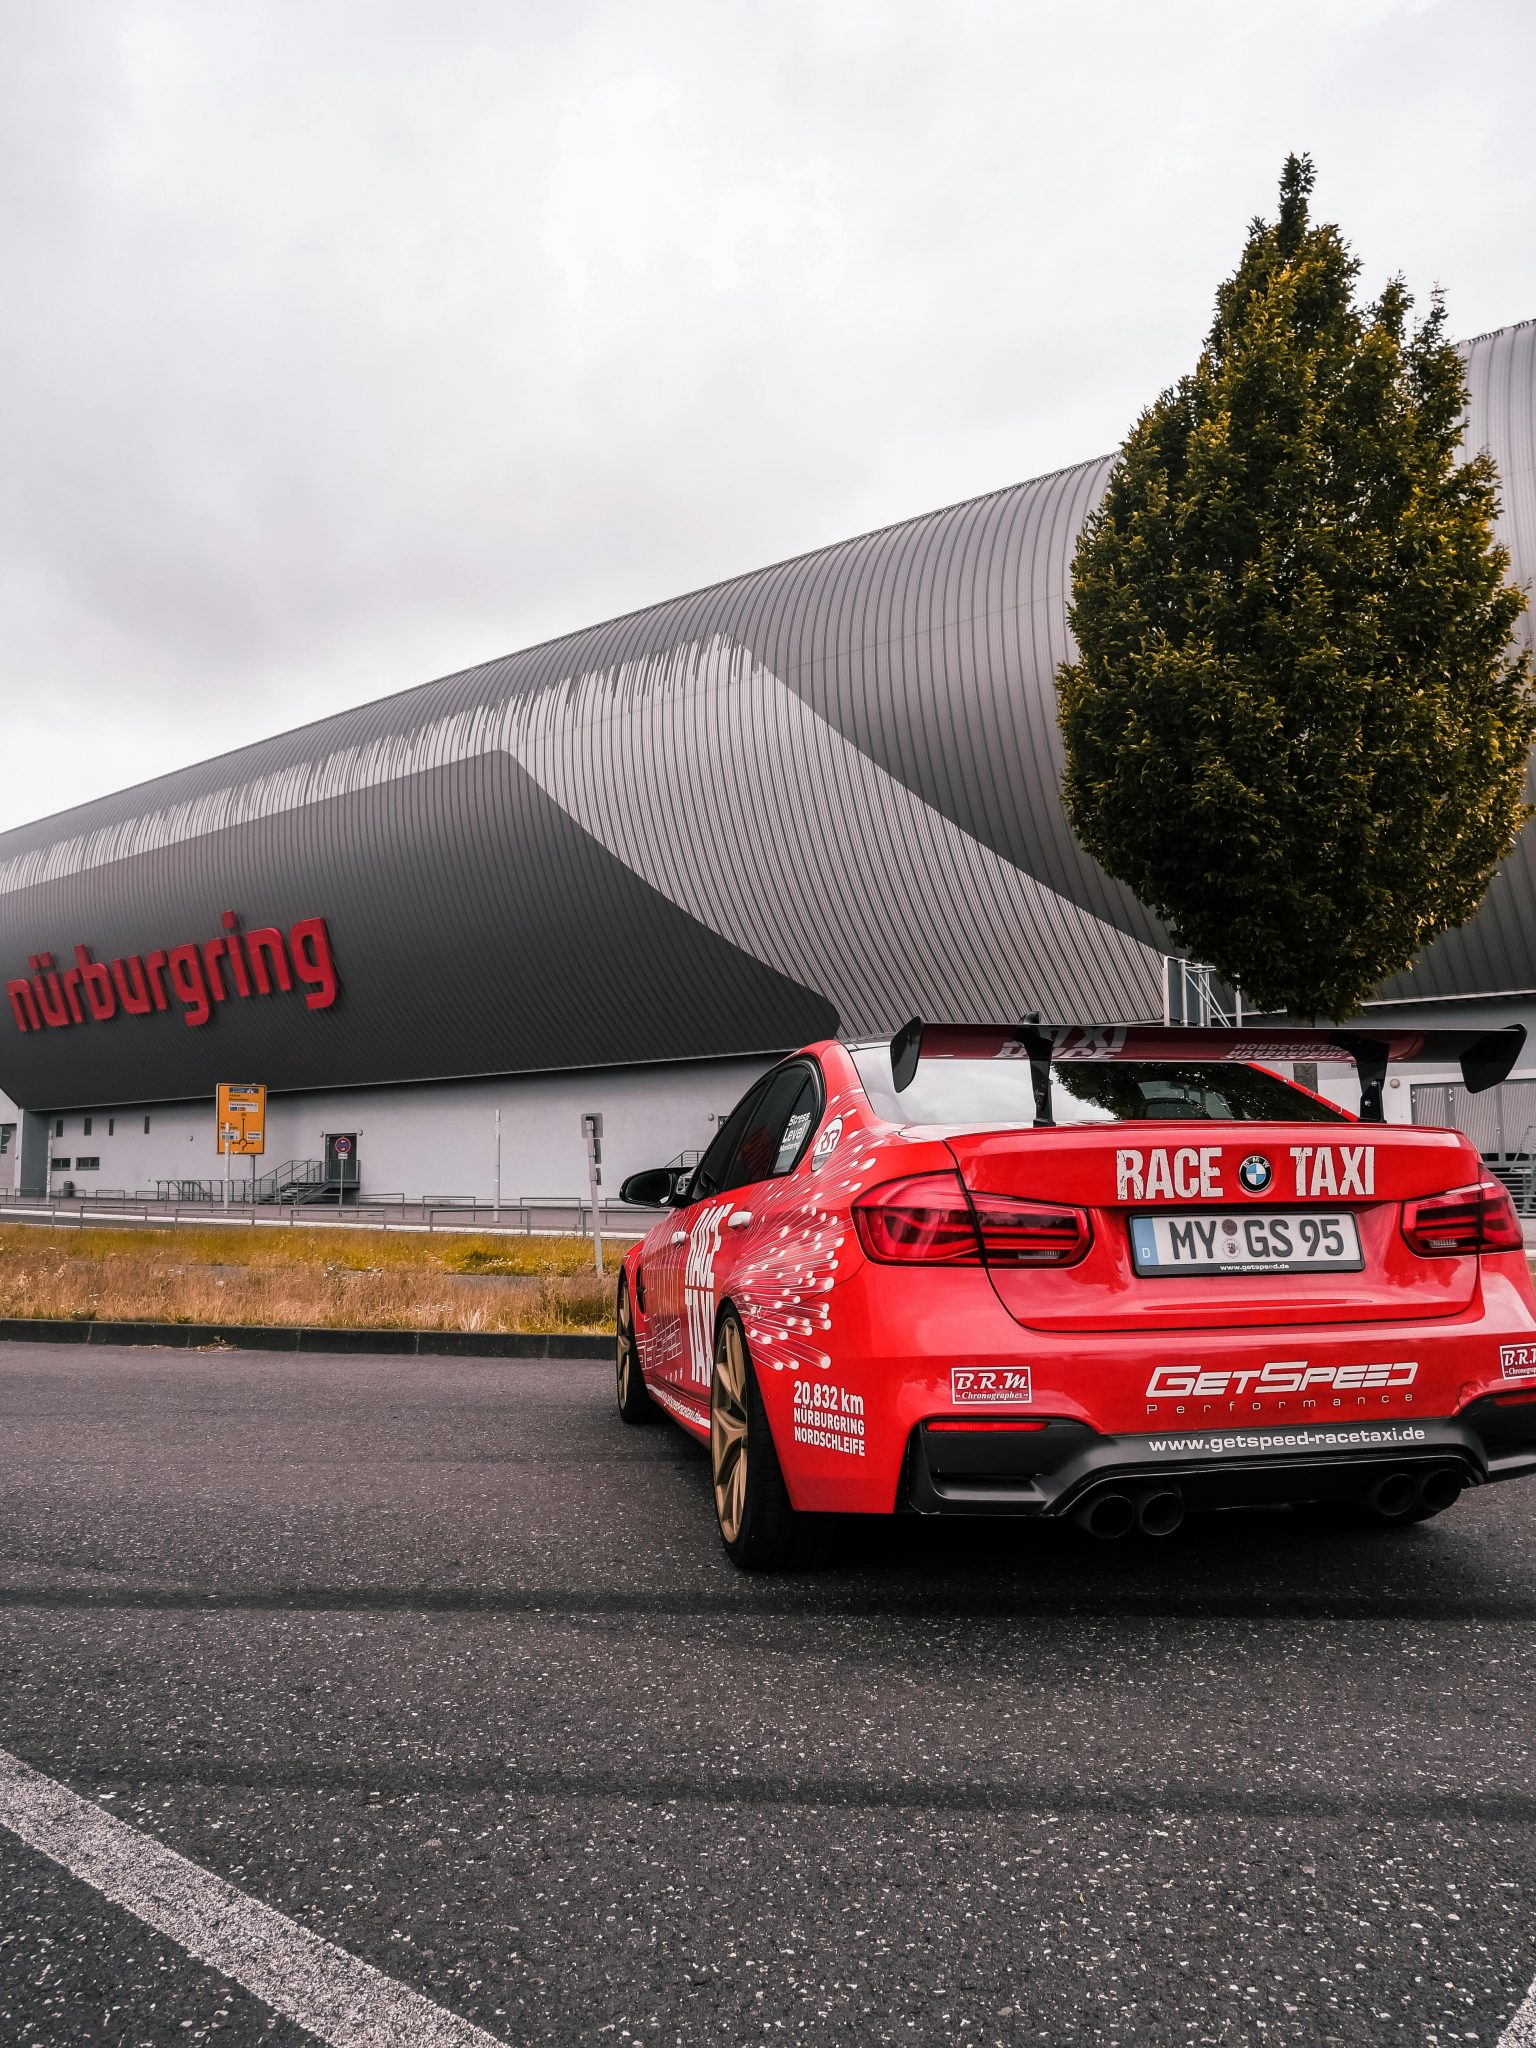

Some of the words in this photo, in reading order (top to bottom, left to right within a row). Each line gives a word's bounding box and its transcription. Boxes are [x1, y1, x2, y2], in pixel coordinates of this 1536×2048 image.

[6, 909, 337, 1032] nürburgring
[782, 1121, 807, 1143] Level
[1116, 1147, 1223, 1200] RACE
[1289, 1146, 1375, 1196] TAXI
[1142, 1247, 1149, 1258] D
[1169, 1220, 1217, 1259] MY
[1244, 1219, 1293, 1258] GS
[1300, 1218, 1344, 1257] 95
[1220, 1262, 1290, 1271] www.getspeed.de
[793, 1380, 838, 1411] 20,832
[841, 1387, 864, 1416] km
[962, 1391, 1023, 1401] Chronographes
[1147, 1392, 1414, 1415] Performance
[793, 1404, 865, 1436] NÜRBURGRING
[794, 1425, 865, 1457] NORDSCHLEIFE
[1149, 1427, 1426, 1452] www.getspeed-racetaxi.de
